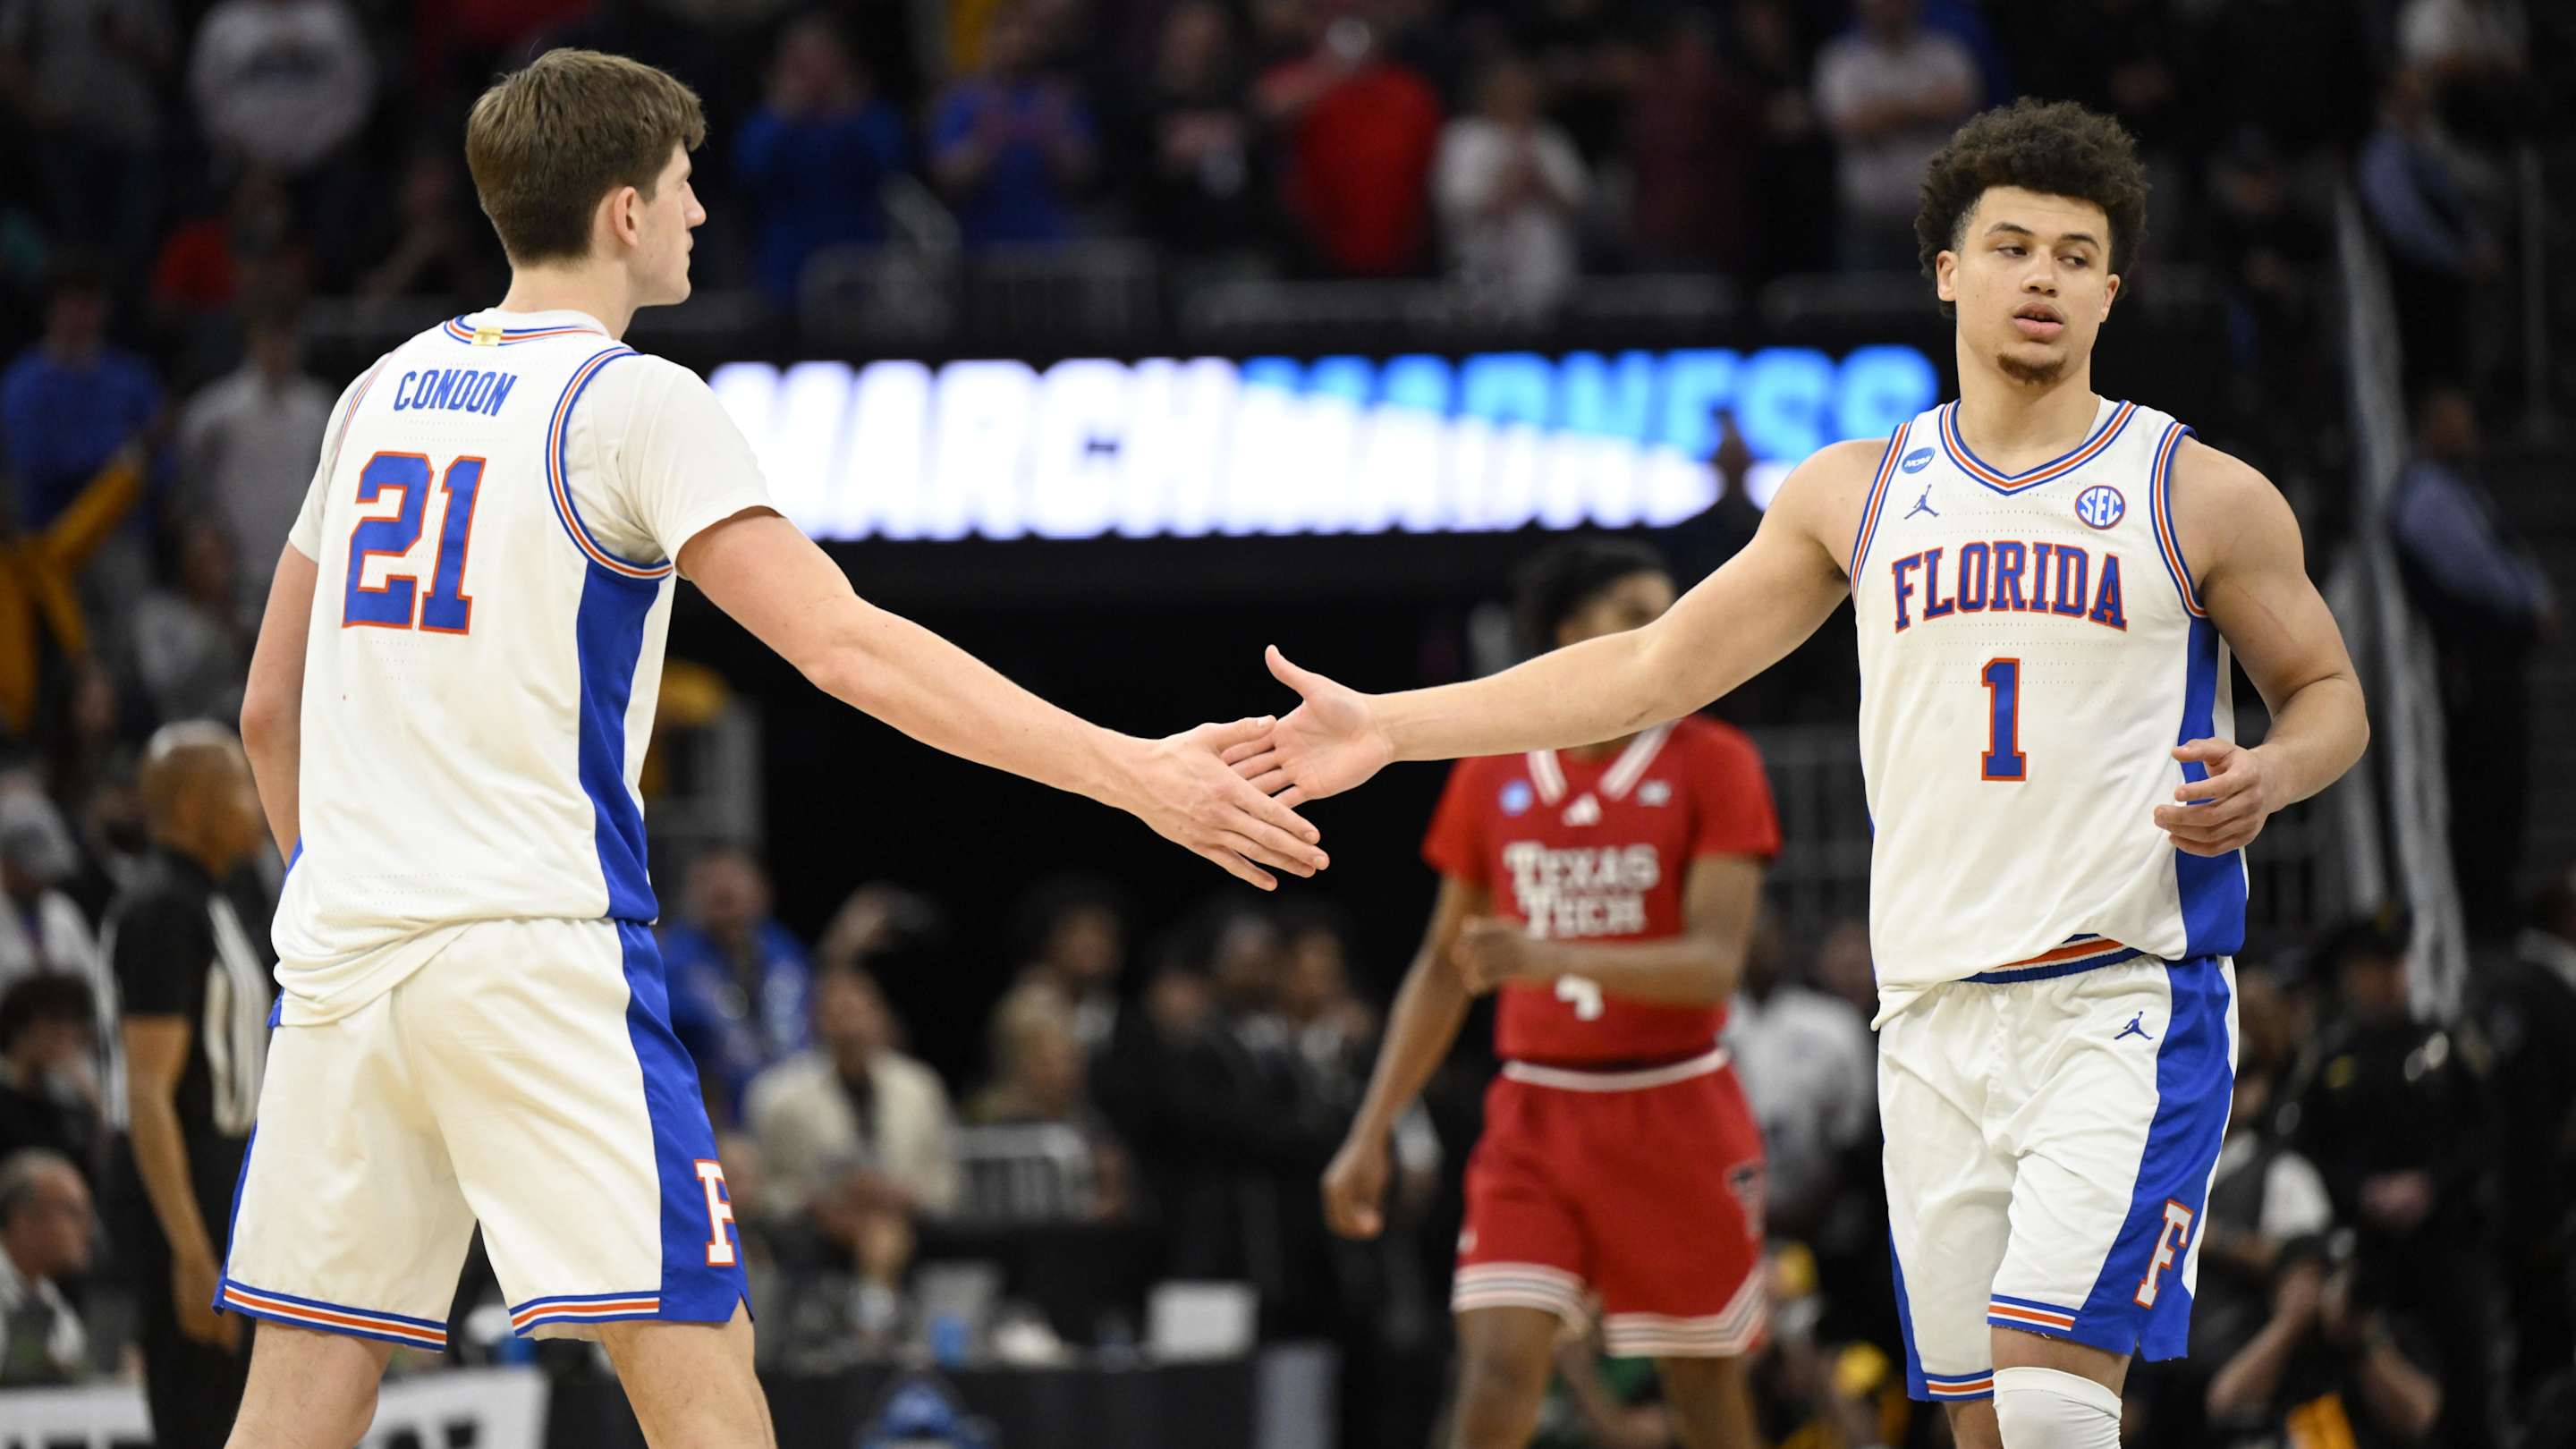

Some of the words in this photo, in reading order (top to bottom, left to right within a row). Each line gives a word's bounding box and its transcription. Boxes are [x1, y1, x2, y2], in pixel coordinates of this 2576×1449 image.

[394, 369, 518, 417] CONDON
[342, 451, 487, 635] 21
[2080, 487, 2122, 526] SEC
[1892, 540, 2128, 633] FLORIDA
[1981, 657, 2027, 782] 1
[1503, 841, 1659, 893] TEXAS
[1519, 890, 1646, 939] TECH
[693, 1159, 736, 1267] F
[2135, 1199, 2194, 1309] F
